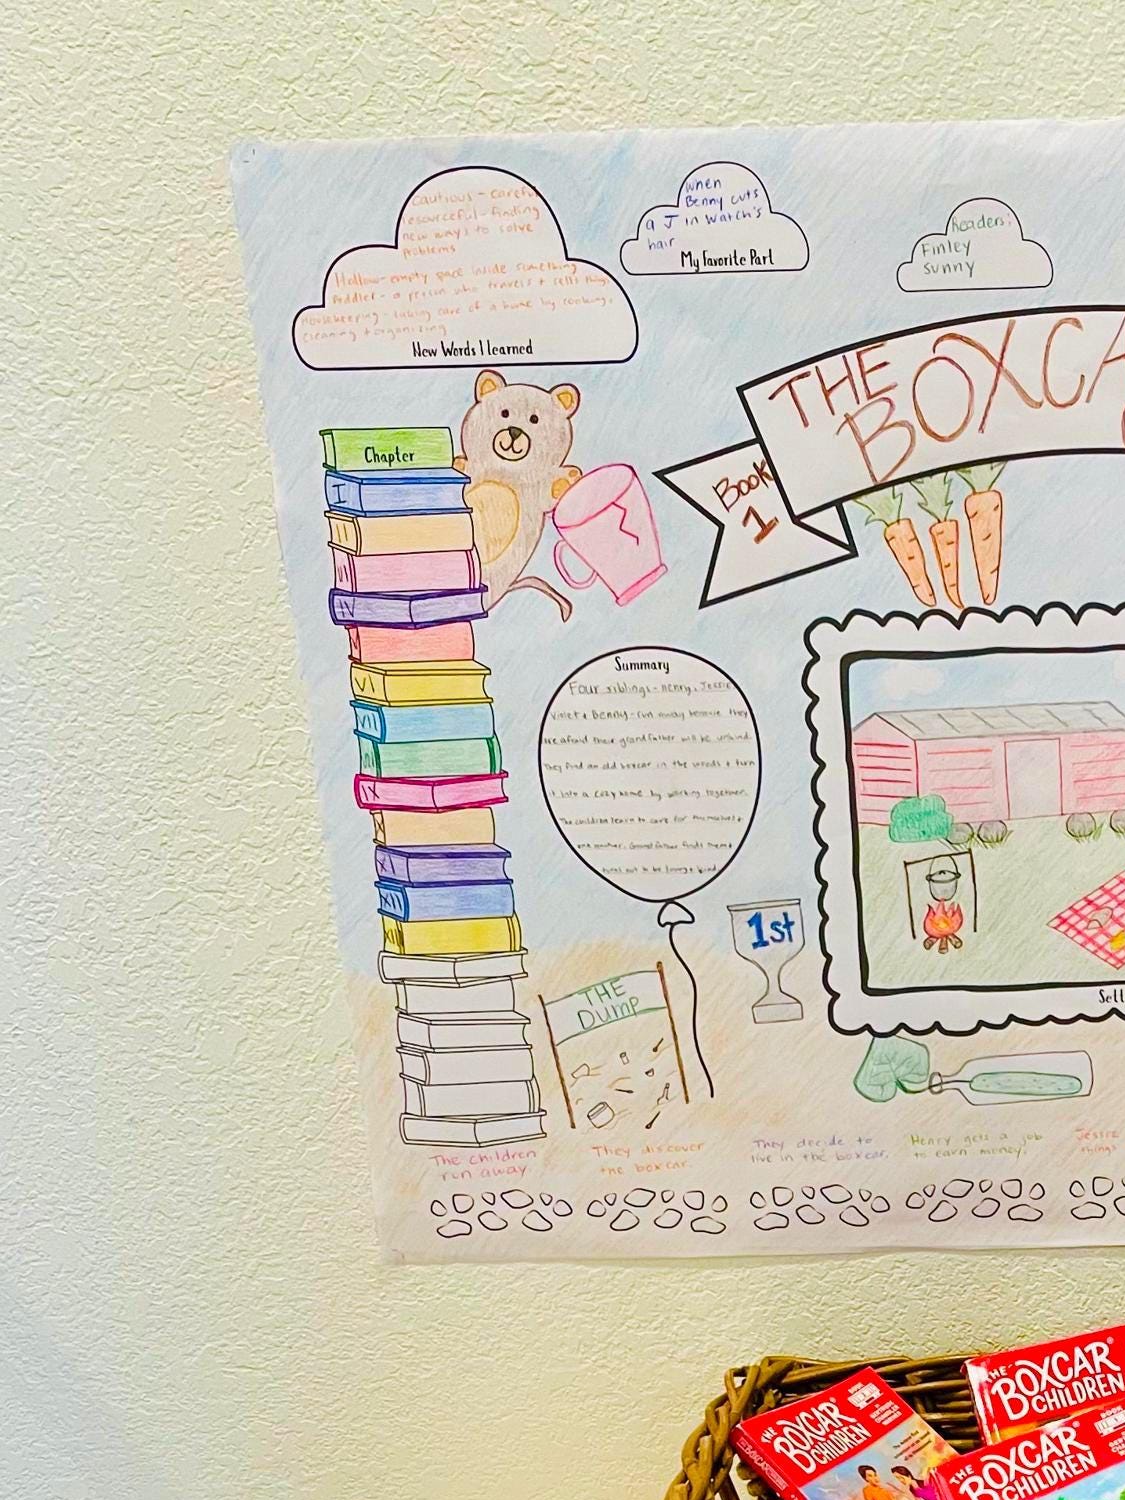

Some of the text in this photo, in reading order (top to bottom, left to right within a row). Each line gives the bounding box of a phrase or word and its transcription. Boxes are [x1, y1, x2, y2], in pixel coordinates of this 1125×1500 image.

[681, 249, 774, 273] My Favorite Part
[413, 341, 437, 358] New
[441, 341, 476, 356] Words
[766, 343, 903, 430] THE
[364, 447, 415, 467] Chapter
[710, 460, 776, 514] Book
[741, 507, 780, 543] 1
[615, 656, 670, 674] Summary
[747, 912, 795, 949] 1st
[577, 977, 626, 1005] THE
[991, 1342, 1121, 1421] BOXCAR
[1031, 1373, 1125, 1414] CHILDREN
[761, 1427, 778, 1443] THE
[773, 1402, 857, 1474] BOXCAR
[811, 1423, 872, 1465] CHILDREN
[951, 1464, 973, 1485] THE
